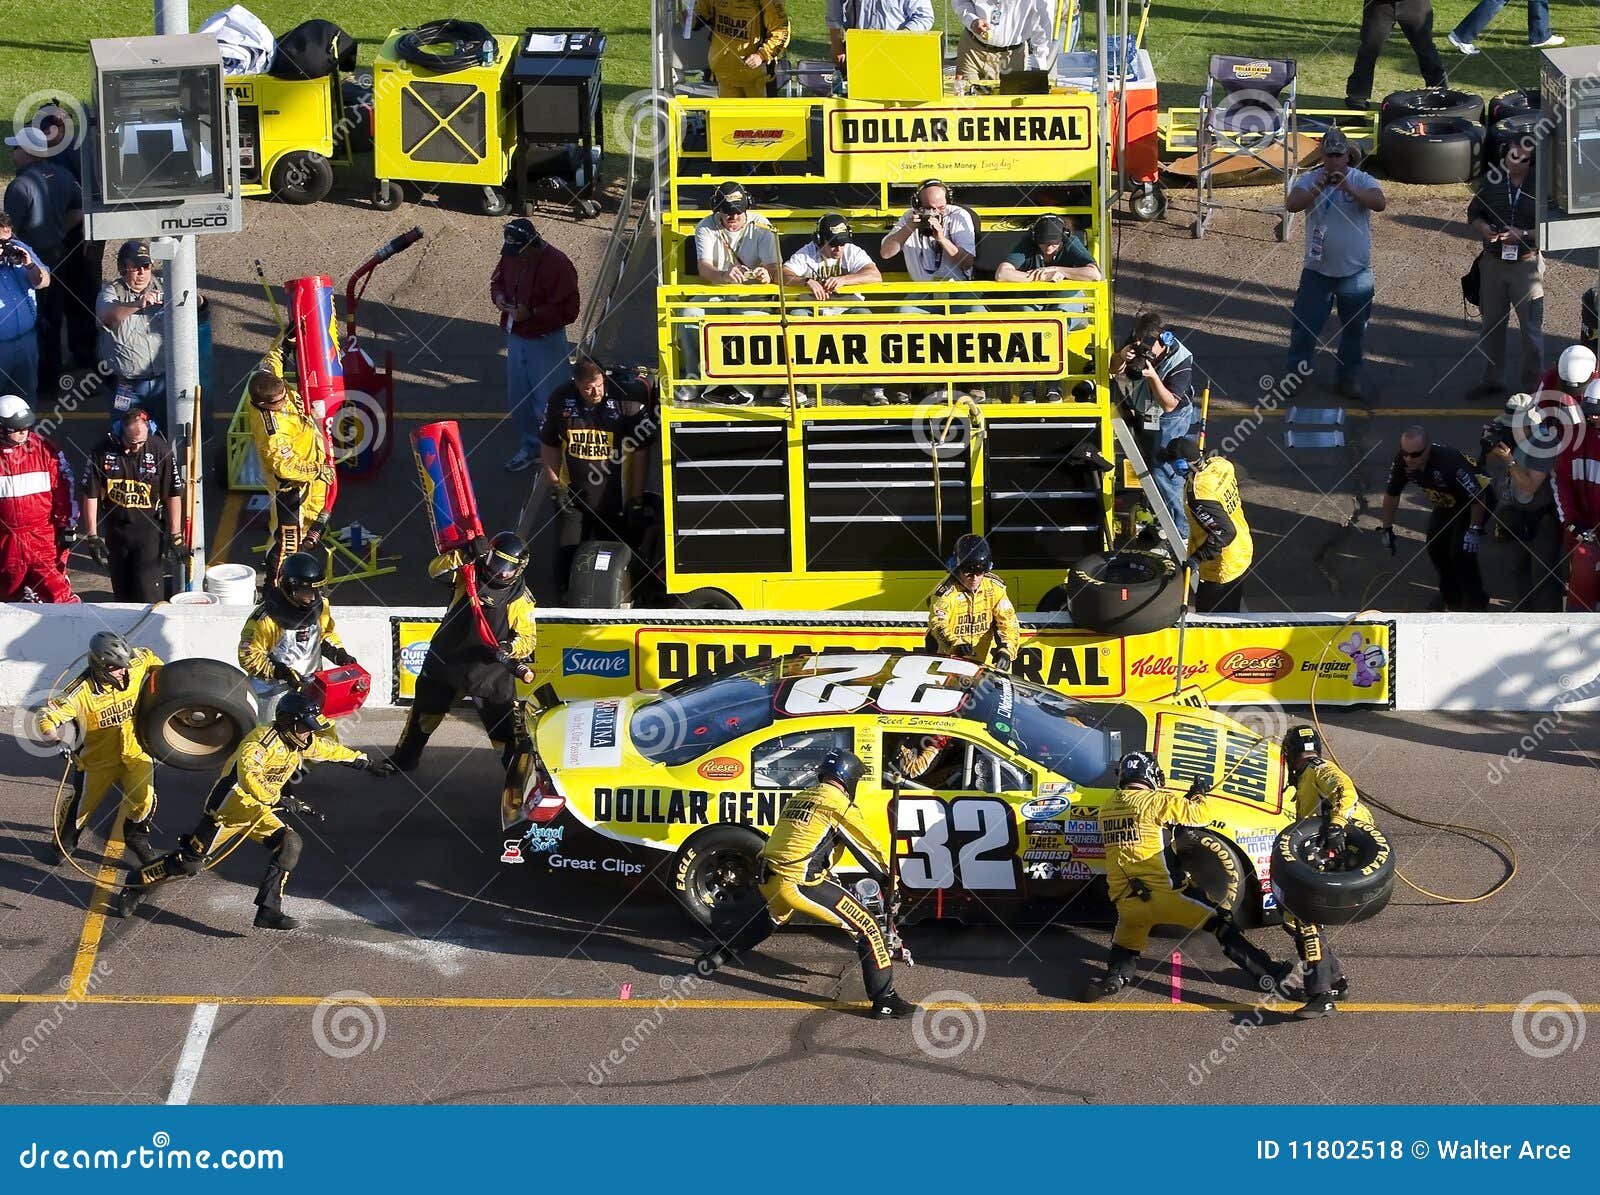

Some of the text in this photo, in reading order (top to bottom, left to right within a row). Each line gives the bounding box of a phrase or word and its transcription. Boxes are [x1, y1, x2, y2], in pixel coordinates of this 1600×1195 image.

[842, 116, 1082, 143] DOLLAR GENERAL
[901, 162, 917, 170] Save
[937, 162, 953, 170] Save
[721, 332, 1050, 366] DOLLAR GENERAL
[572, 432, 609, 445] DOLLAR
[570, 443, 612, 457] GENERAL
[110, 489, 150, 505] GENERAL
[954, 621, 989, 635] GENERAL
[958, 612, 988, 625] DOLLAR
[566, 652, 625, 672] Suave
[1131, 654, 1208, 679] Kellogg's
[1223, 652, 1285, 671] Reese's
[1301, 659, 1351, 674] Energizer
[100, 709, 136, 727] GENERAL
[101, 699, 133, 718] DOLLAR
[593, 706, 616, 747] PURINA
[877, 714, 957, 727] Reed Sorenson
[702, 760, 740, 773] Reese's
[594, 787, 709, 824] DOLLAR
[524, 823, 565, 841] Angel
[1068, 821, 1098, 833] Mobil
[531, 837, 559, 853] Soft
[897, 799, 1017, 890] 32
[1279, 833, 1297, 863] EAGLE
[1354, 820, 1391, 877] GOODYEAR
[548, 854, 643, 876] Great Clips
[676, 847, 698, 891] EAGLE
[1061, 862, 1089, 874] MAC
[1200, 836, 1240, 911] GOODYEA
[840, 900, 869, 929] DOLLAR
